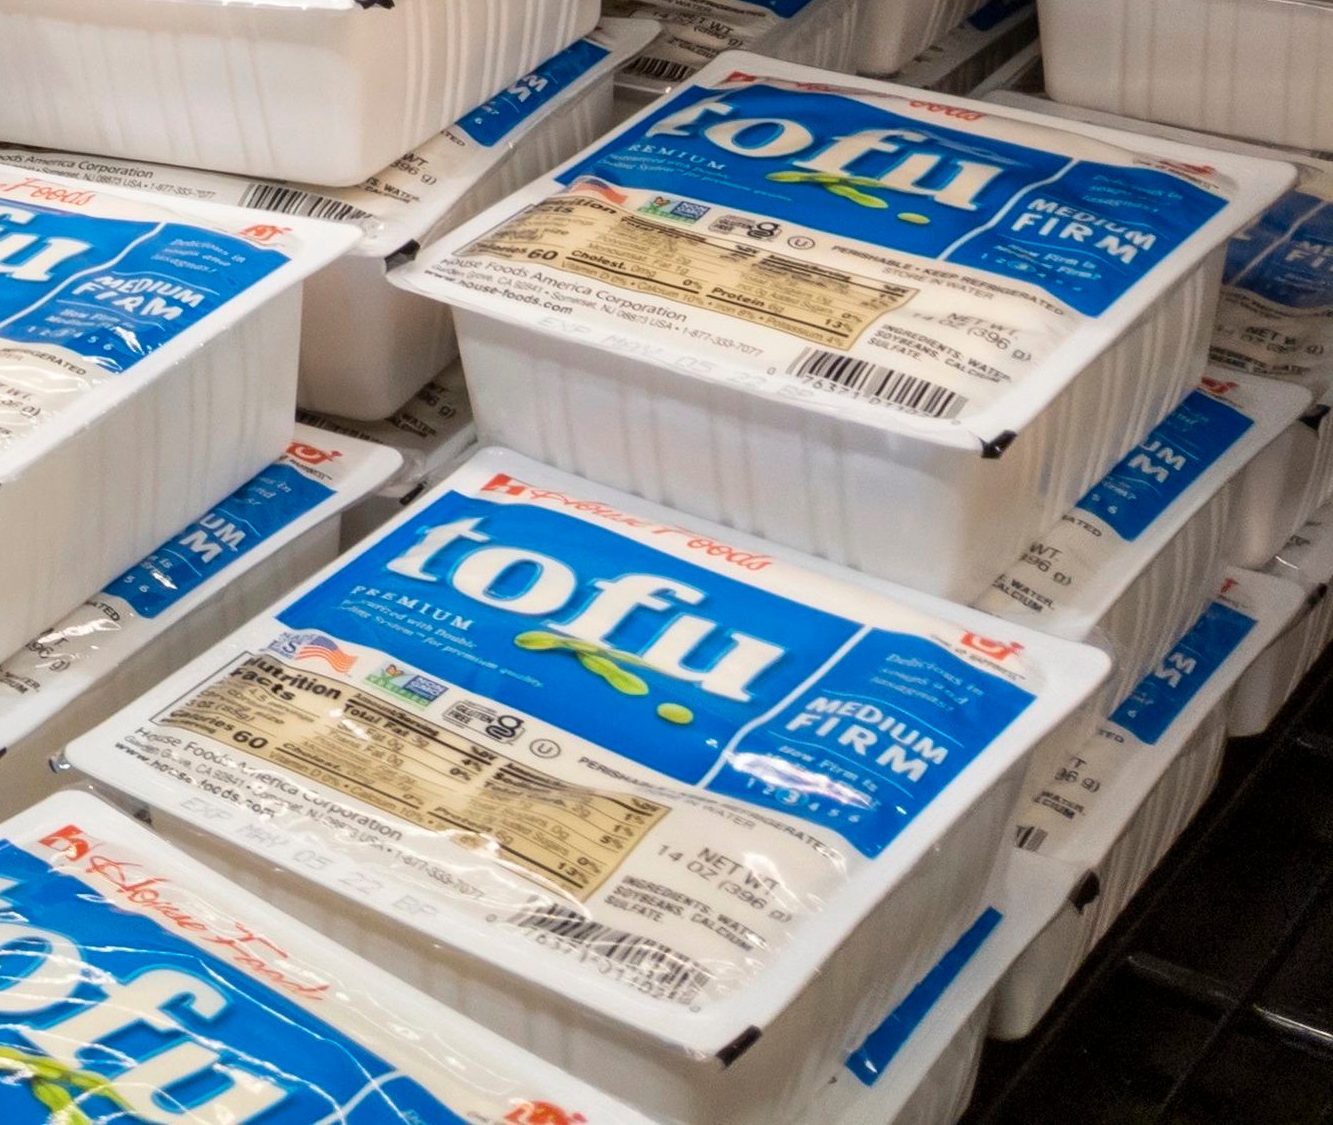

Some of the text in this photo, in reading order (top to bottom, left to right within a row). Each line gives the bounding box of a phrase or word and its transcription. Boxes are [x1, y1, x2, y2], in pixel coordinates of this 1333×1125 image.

[75, 162, 155, 181] Corporation
[644, 94, 1006, 212] tofu
[19, 176, 99, 207] Foods
[1011, 211, 1139, 264] FIRM
[1028, 197, 1157, 251] MEDIUM
[528, 248, 559, 263] 60
[95, 274, 206, 310] MEDIUM
[532, 274, 688, 322] America Corporation
[711, 287, 765, 308] Protein
[530, 486, 776, 572] House Foods
[348, 584, 476, 634] PREMIUM
[387, 515, 788, 704] tofu
[245, 655, 342, 702] Nutrition
[232, 729, 269, 751] 60
[343, 703, 413, 738] Total Fat
[803, 694, 949, 765] MEDIUM
[785, 712, 930, 784] FIRM
[302, 789, 404, 841] Corporation
[657, 844, 720, 883] 14 OZ
[697, 846, 736, 875] NET
